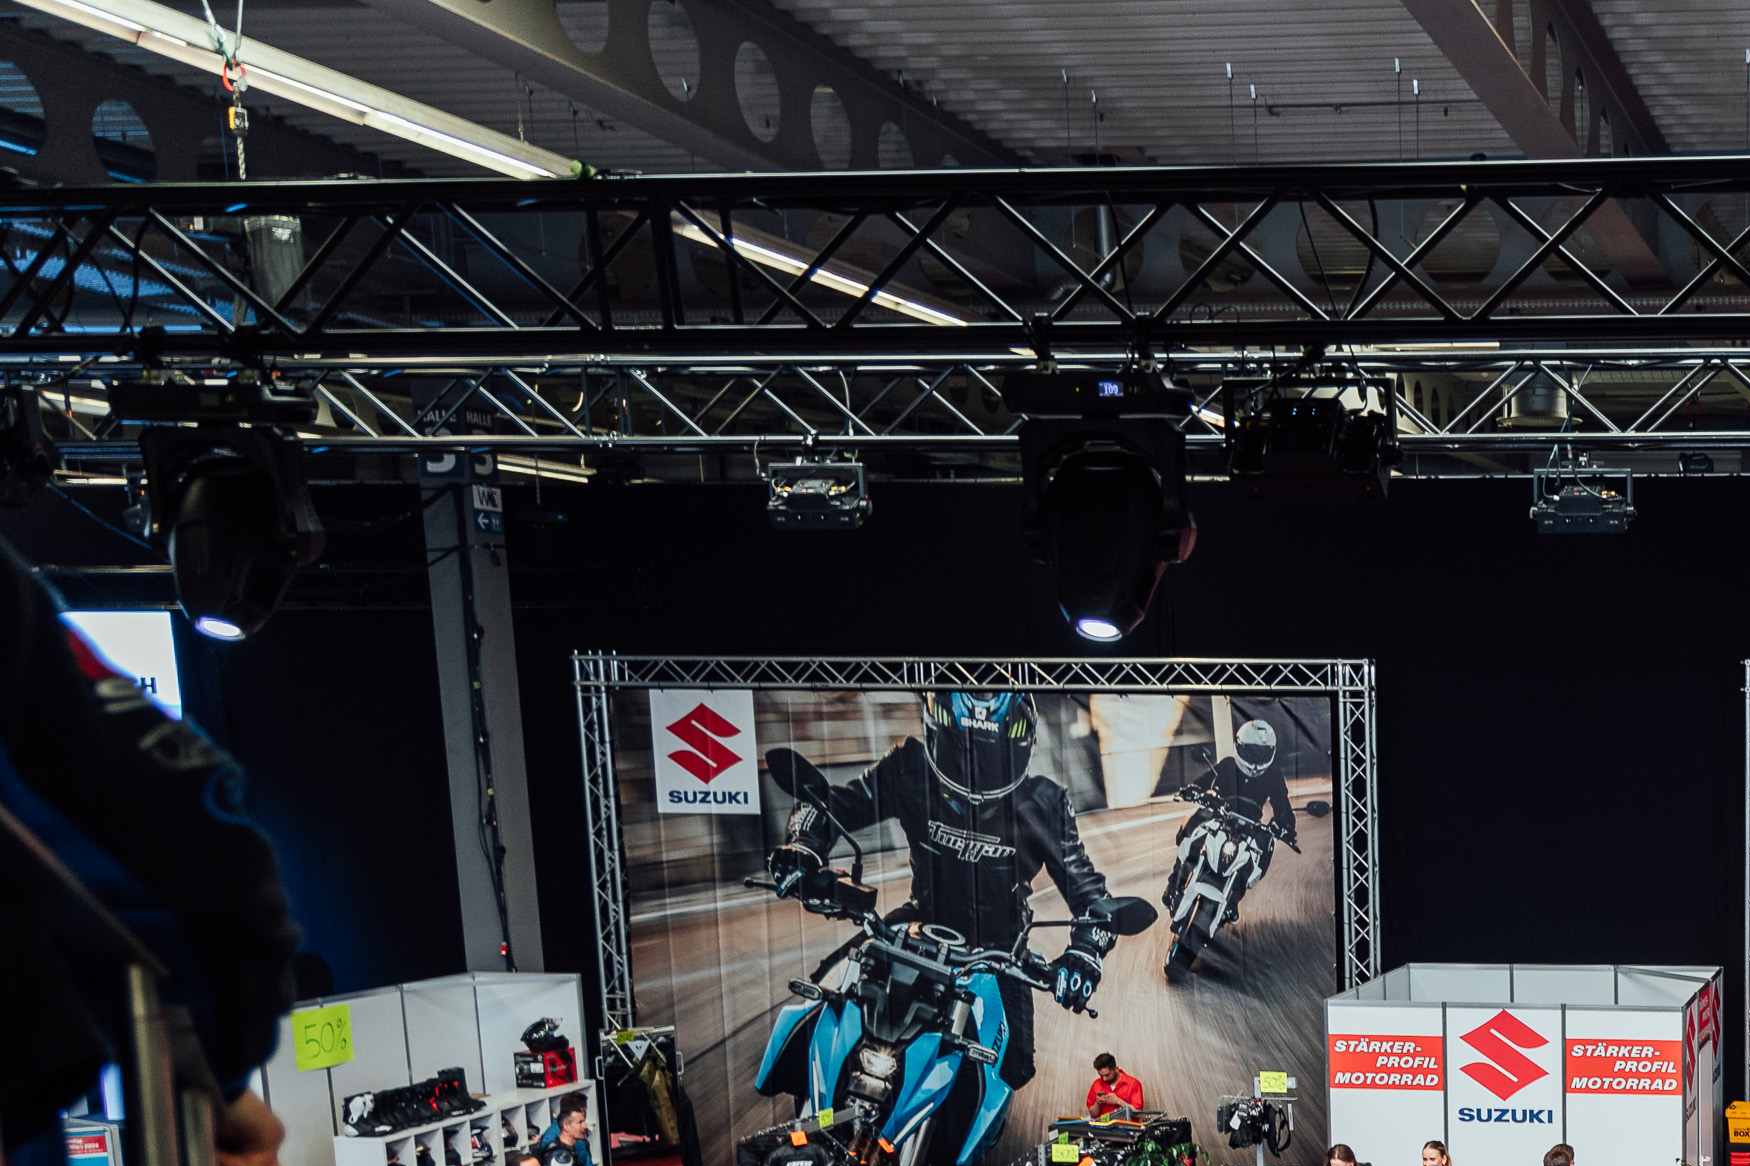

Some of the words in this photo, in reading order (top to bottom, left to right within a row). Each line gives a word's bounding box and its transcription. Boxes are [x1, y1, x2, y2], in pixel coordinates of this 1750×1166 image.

[465, 411, 493, 427] HALLE
[960, 717, 1000, 732] SHARK
[668, 789, 749, 805] SUZUKI
[304, 1017, 347, 1060] 50%
[1333, 1037, 1423, 1054] STÄRKER-
[1570, 1042, 1661, 1059] STÄRKER-
[1375, 1055, 1439, 1070] PROFIL
[1613, 1060, 1677, 1074] PROFIL
[1262, 1075, 1287, 1090] 50%
[1333, 1072, 1440, 1087] MOTORRAD
[1570, 1076, 1678, 1091] MOTORRAD
[1457, 1107, 1554, 1125] SUZUKI
